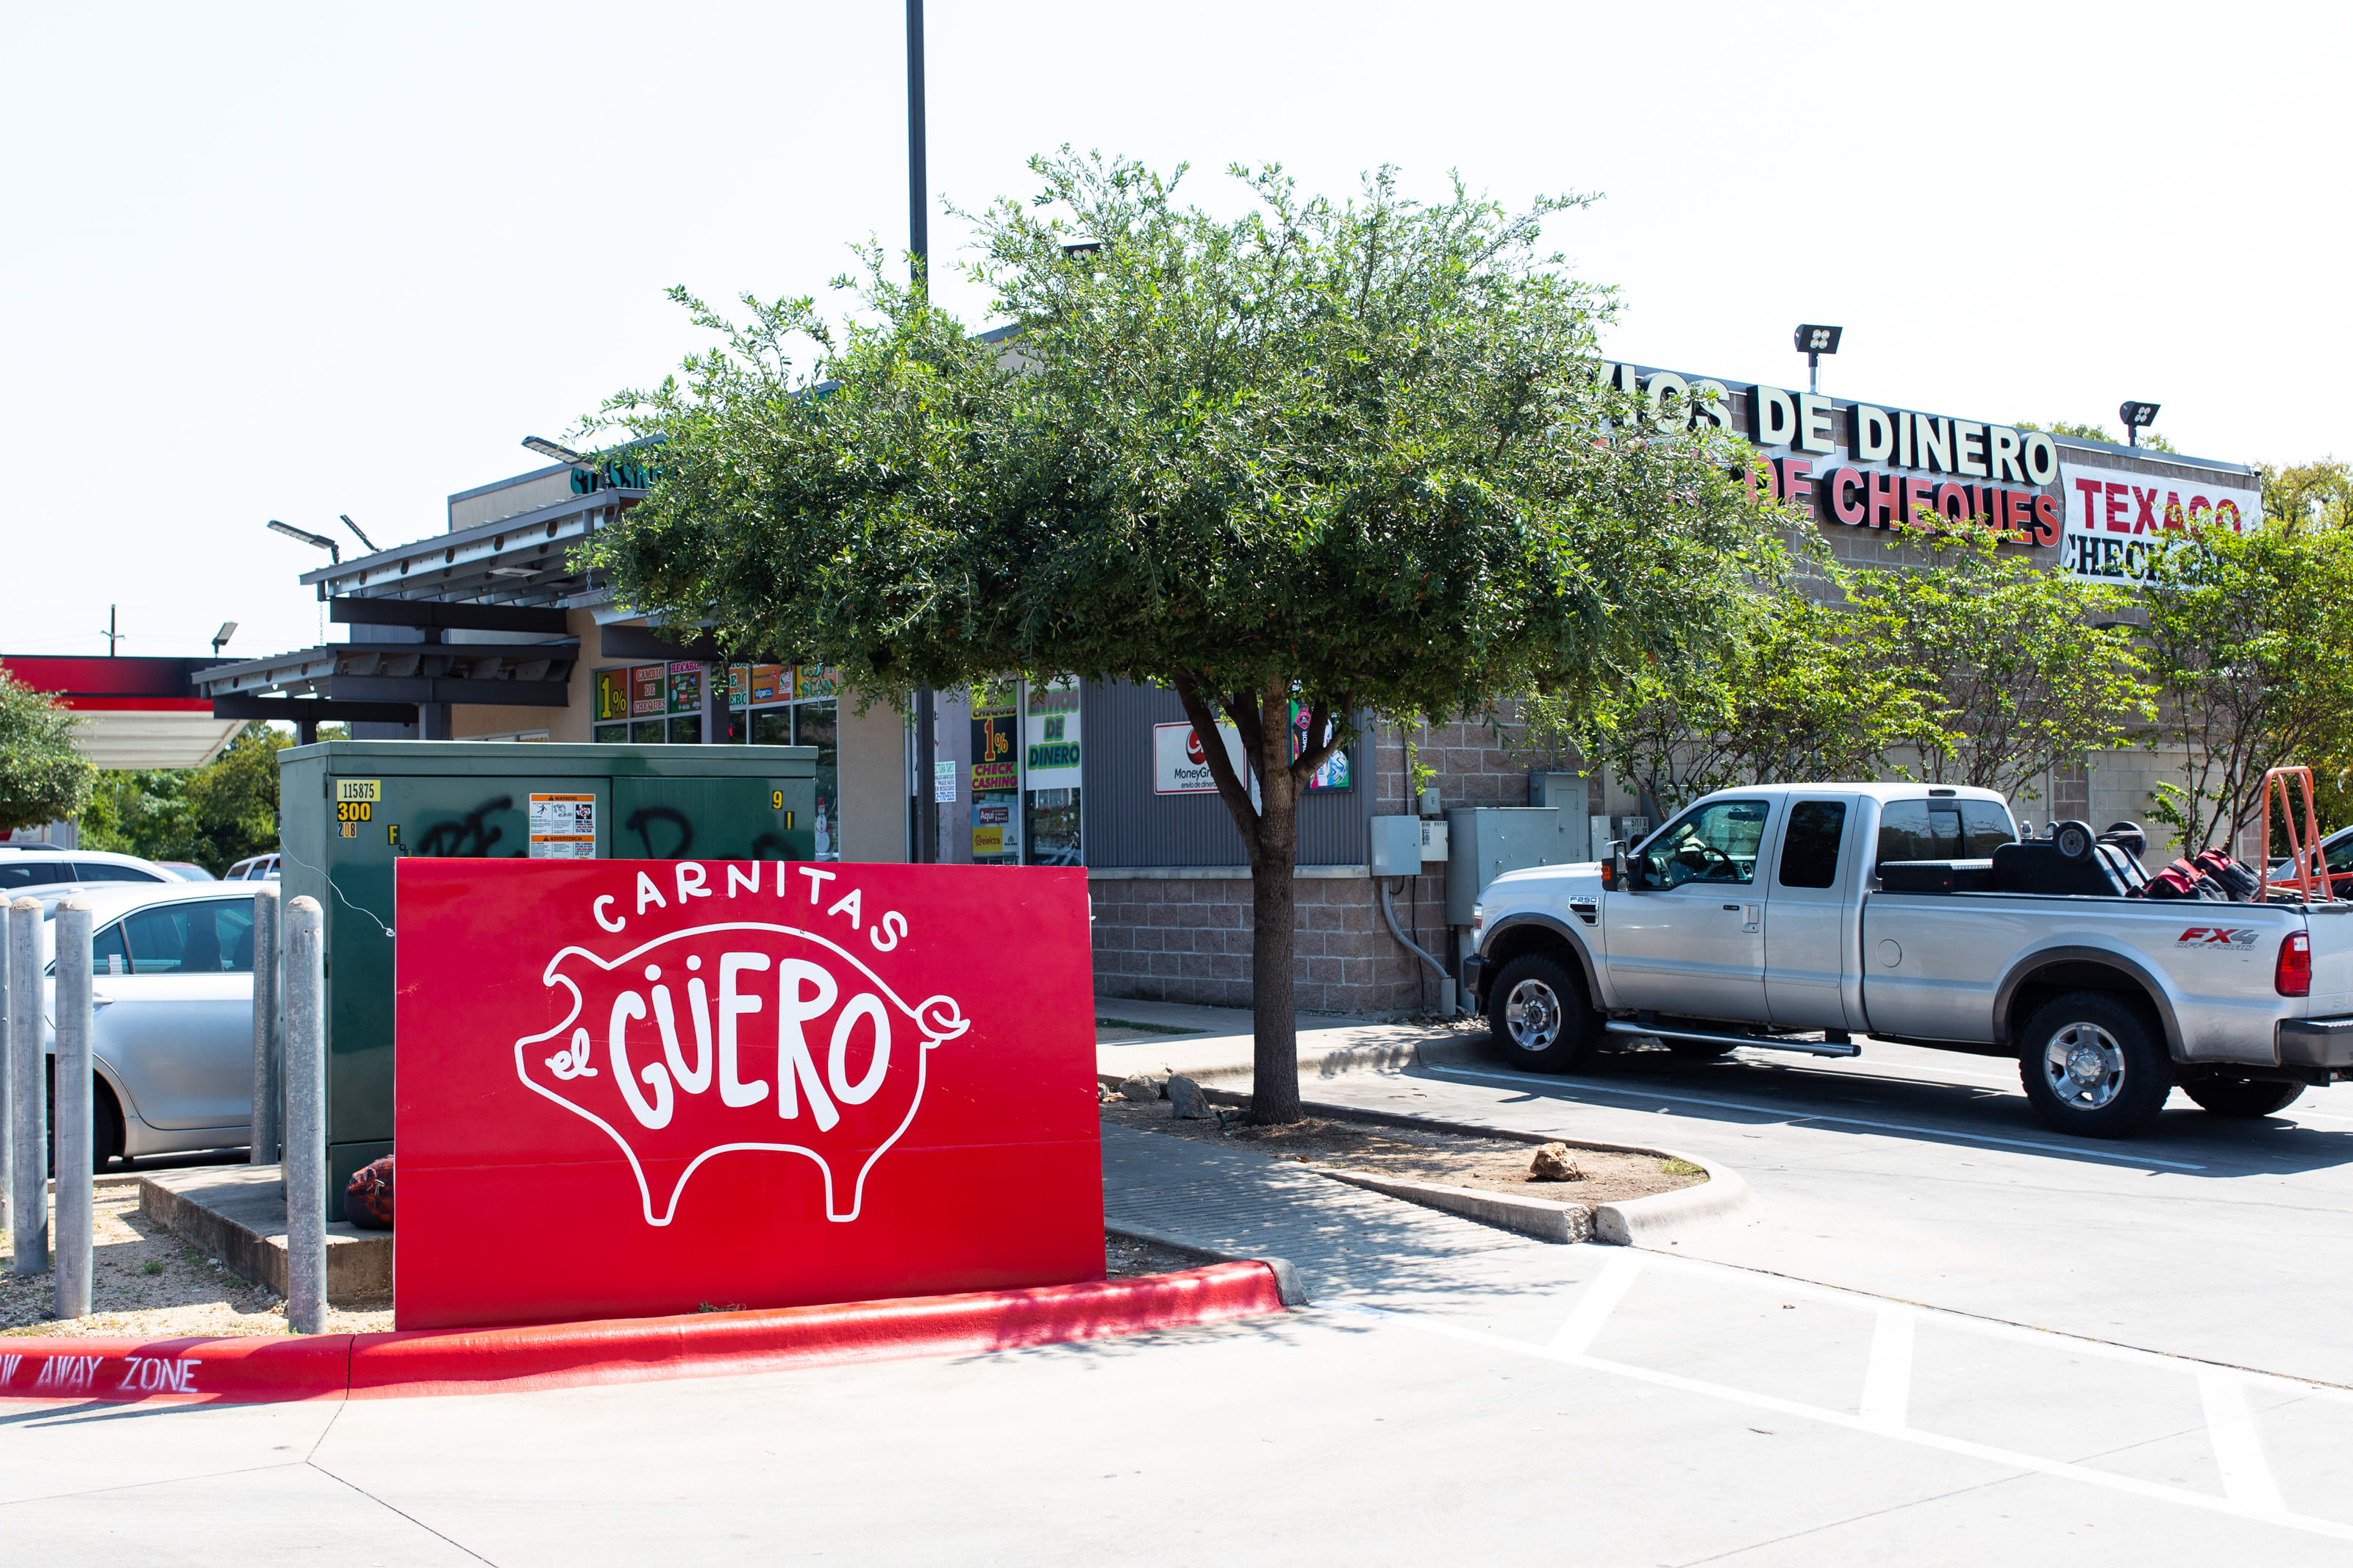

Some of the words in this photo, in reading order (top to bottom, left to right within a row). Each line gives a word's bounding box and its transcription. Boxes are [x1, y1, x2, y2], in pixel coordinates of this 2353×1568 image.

[1756, 384, 1836, 454] DE
[1857, 404, 2059, 487] DINERO
[1832, 465, 2060, 548] CHEQUES
[636, 667, 664, 681] CAMBIO
[601, 677, 626, 718] 1%
[644, 684, 655, 696] DE
[634, 699, 665, 713] CHEQUES
[1029, 690, 1079, 712] ENVIOS
[973, 705, 1017, 718] CHEQUES
[1046, 719, 1063, 739] DE
[985, 718, 1008, 761] 1%
[1029, 743, 1080, 766] DINERO
[975, 762, 1015, 776] CHECK
[343, 783, 374, 798] 115875
[972, 776, 1018, 790] CASHING
[773, 790, 782, 809] 9
[338, 803, 371, 821] 300
[338, 823, 356, 837] 208
[389, 825, 398, 845] F
[593, 861, 908, 951] CARNITAS
[2178, 927, 2260, 945] FX4
[2208, 942, 2256, 951] ROAD
[545, 1027, 598, 1081] el
[608, 951, 892, 1133] GÜERO
[35, 1355, 104, 1389] AWAY
[118, 1356, 202, 1393] ZONE
